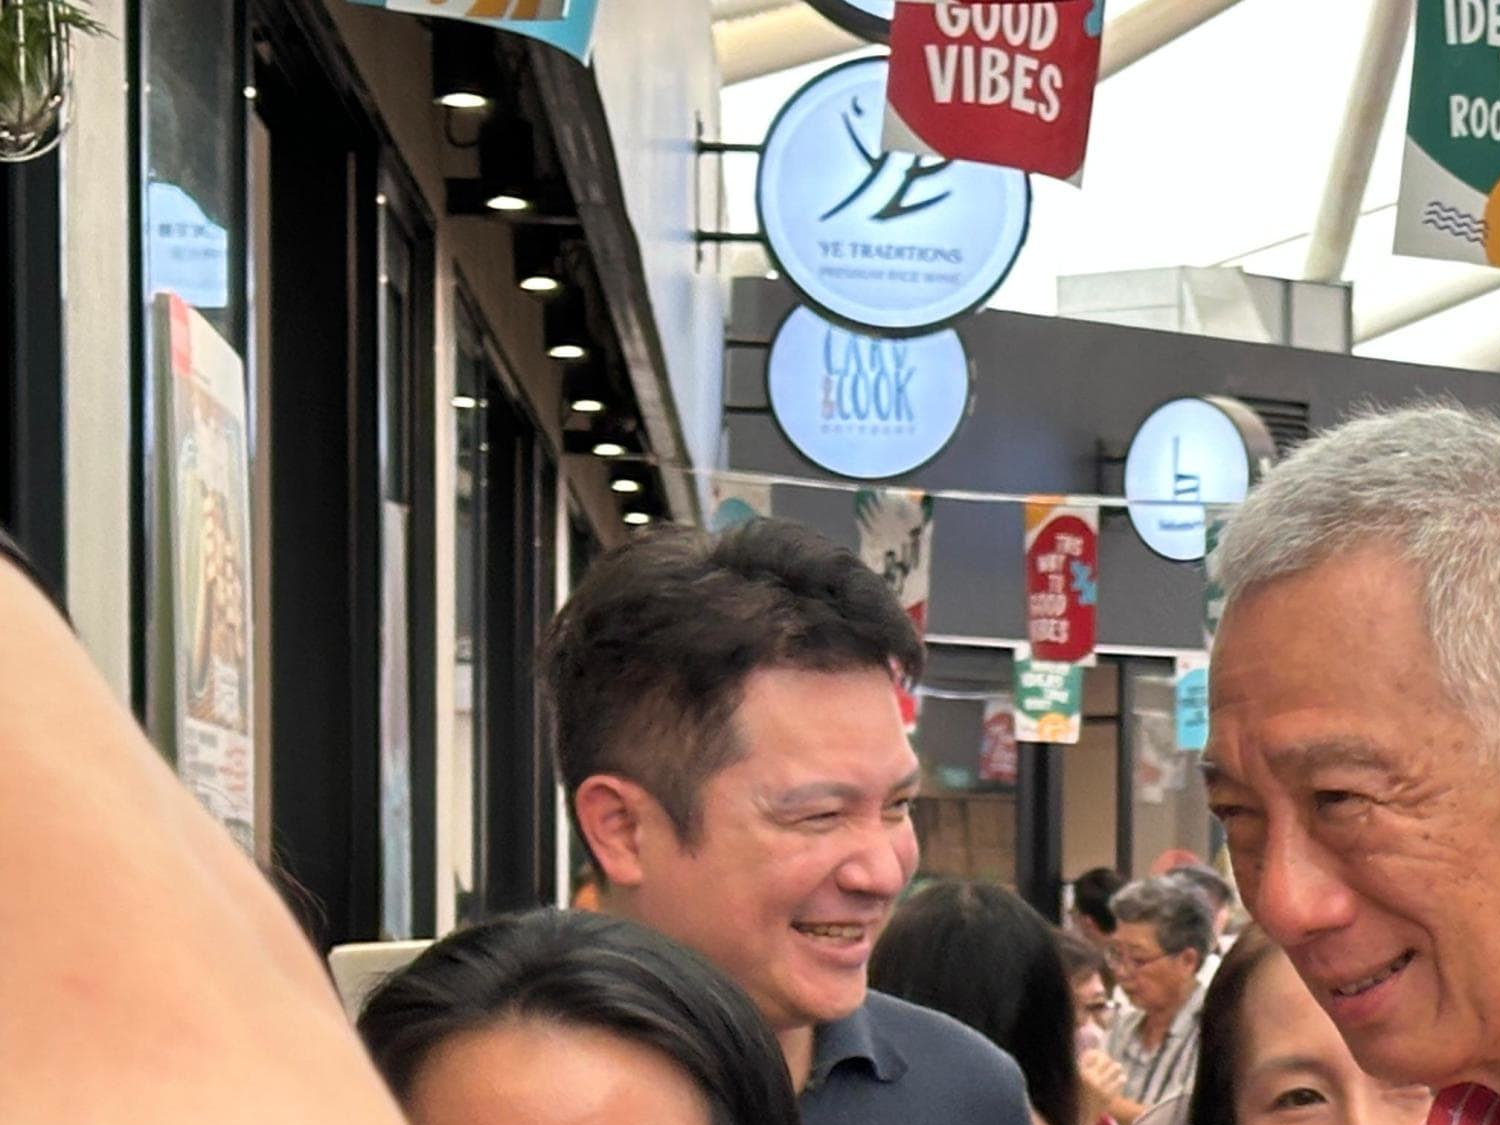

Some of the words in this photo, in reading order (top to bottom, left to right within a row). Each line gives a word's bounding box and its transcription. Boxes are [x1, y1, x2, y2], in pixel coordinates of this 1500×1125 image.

[935, 2, 1058, 51] GOOD
[924, 44, 1063, 122] VIBES
[847, 242, 963, 264] TRADITIONS
